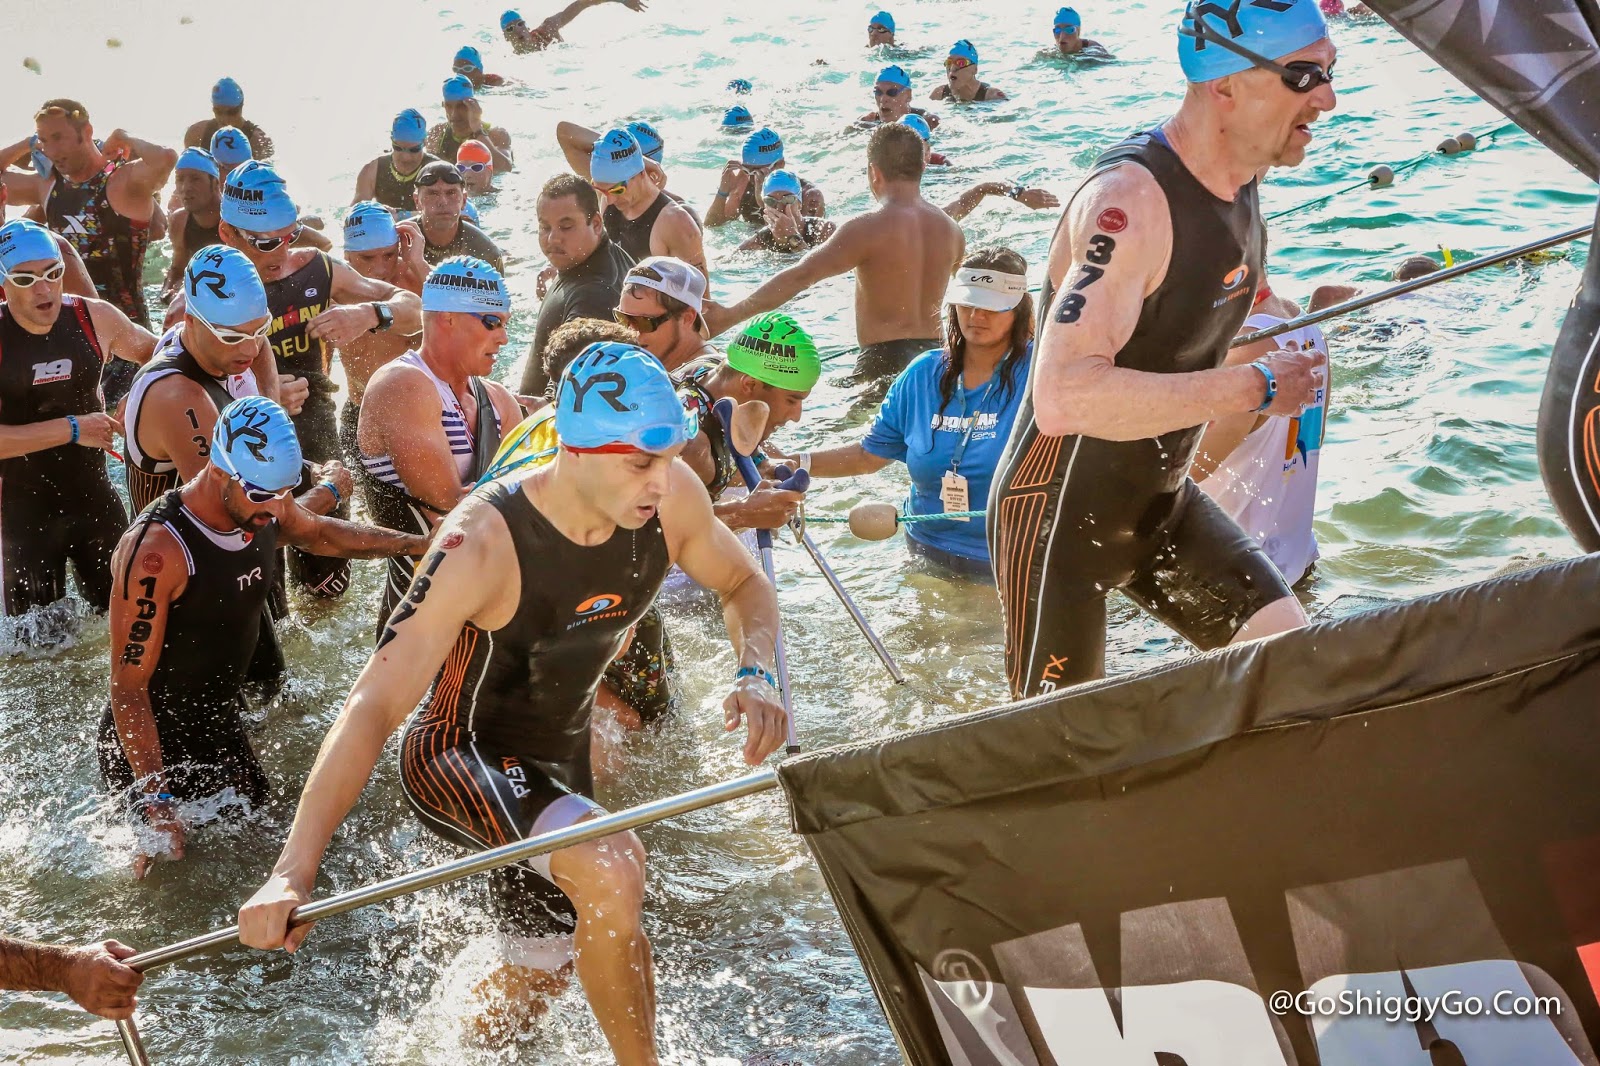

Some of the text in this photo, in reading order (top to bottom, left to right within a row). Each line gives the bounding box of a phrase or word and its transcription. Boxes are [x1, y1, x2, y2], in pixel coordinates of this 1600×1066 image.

[184, 266, 230, 298] YR
[427, 271, 500, 291] IRONMAN
[445, 285, 501, 296] CHAMPIONSHIP
[1055, 234, 1116, 323] 378
[32, 358, 73, 381] 19
[763, 361, 800, 371] GoPro
[556, 371, 632, 413] YR
[185, 408, 211, 457] 13
[215, 417, 269, 463] YR
[236, 566, 263, 591] TYR
[566, 610, 628, 631] blueseventy
